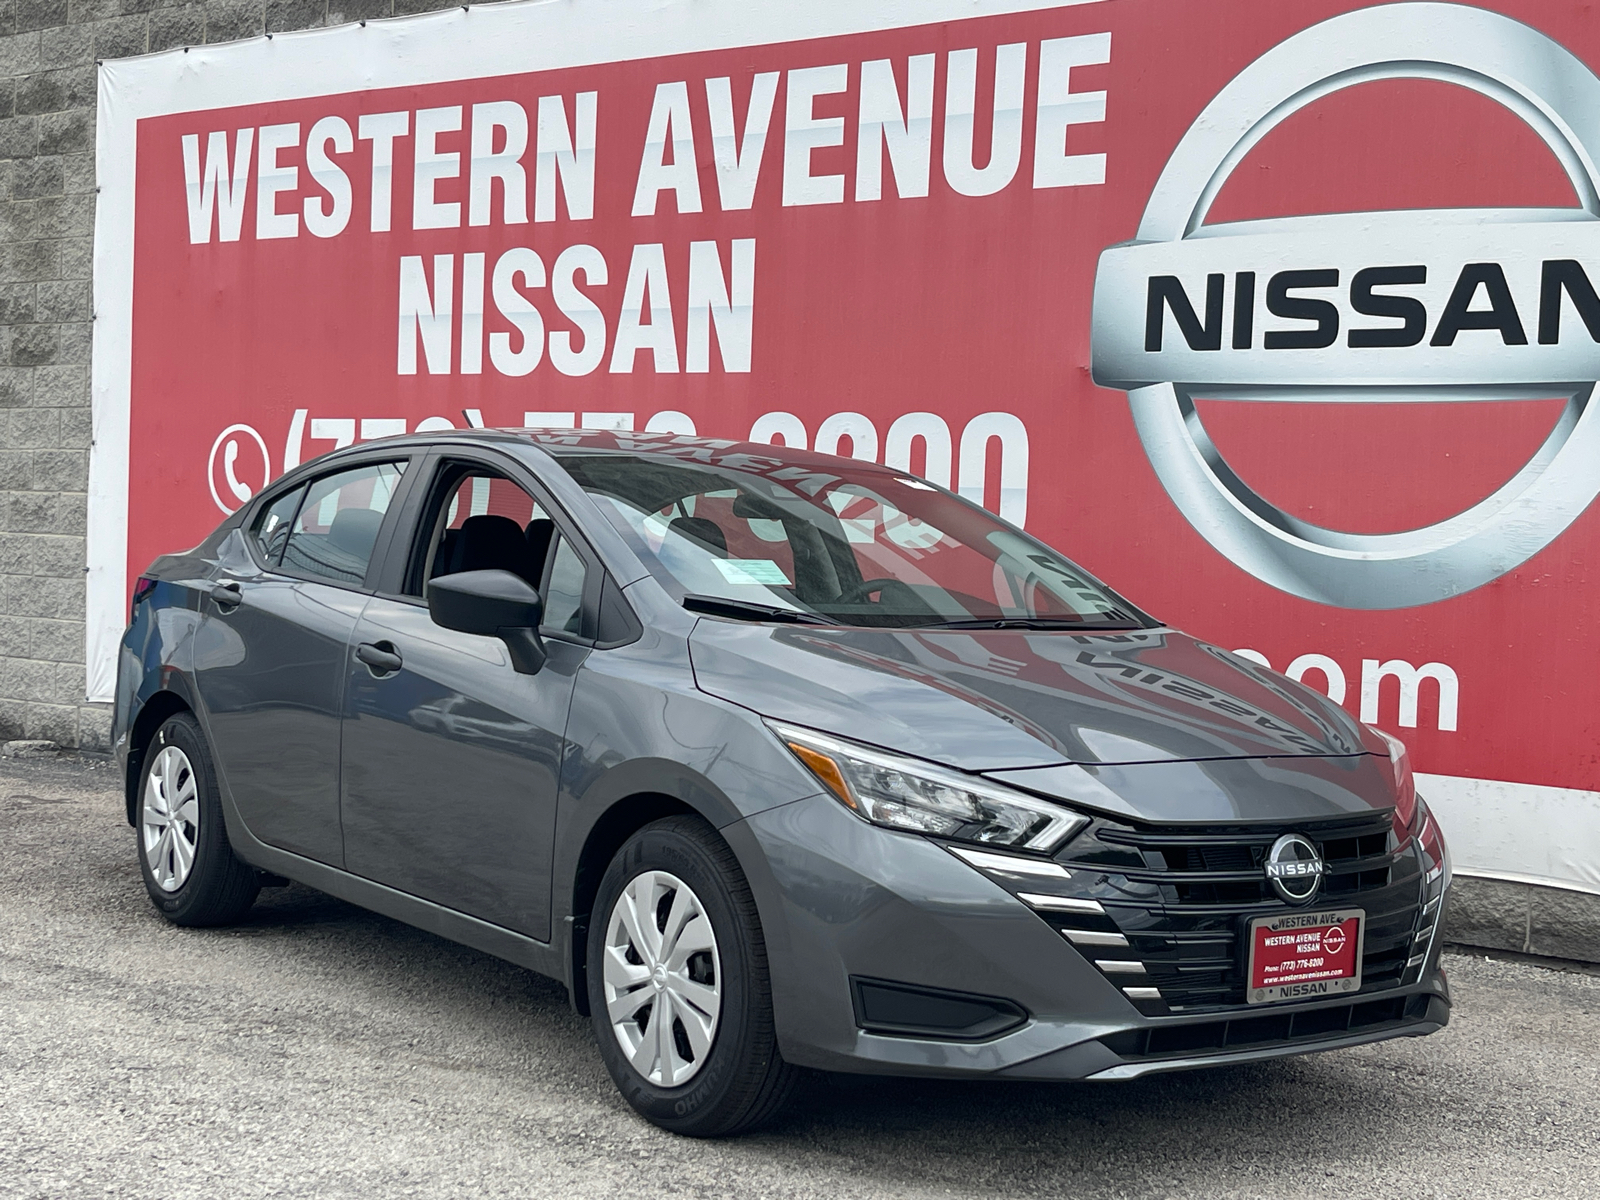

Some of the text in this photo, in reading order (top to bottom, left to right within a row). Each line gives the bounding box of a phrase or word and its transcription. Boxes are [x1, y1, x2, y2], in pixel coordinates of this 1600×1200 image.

[182, 32, 1112, 245] WESTERN AVENUE
[397, 238, 756, 377] NISSAN
[1267, 861, 1323, 876] NISSAN
[1278, 915, 1318, 929] WESTERN
[1264, 932, 1321, 947] WESTERN AVENUE
[1296, 943, 1321, 954] NISSAN
[1280, 982, 1327, 998] NISSAN
